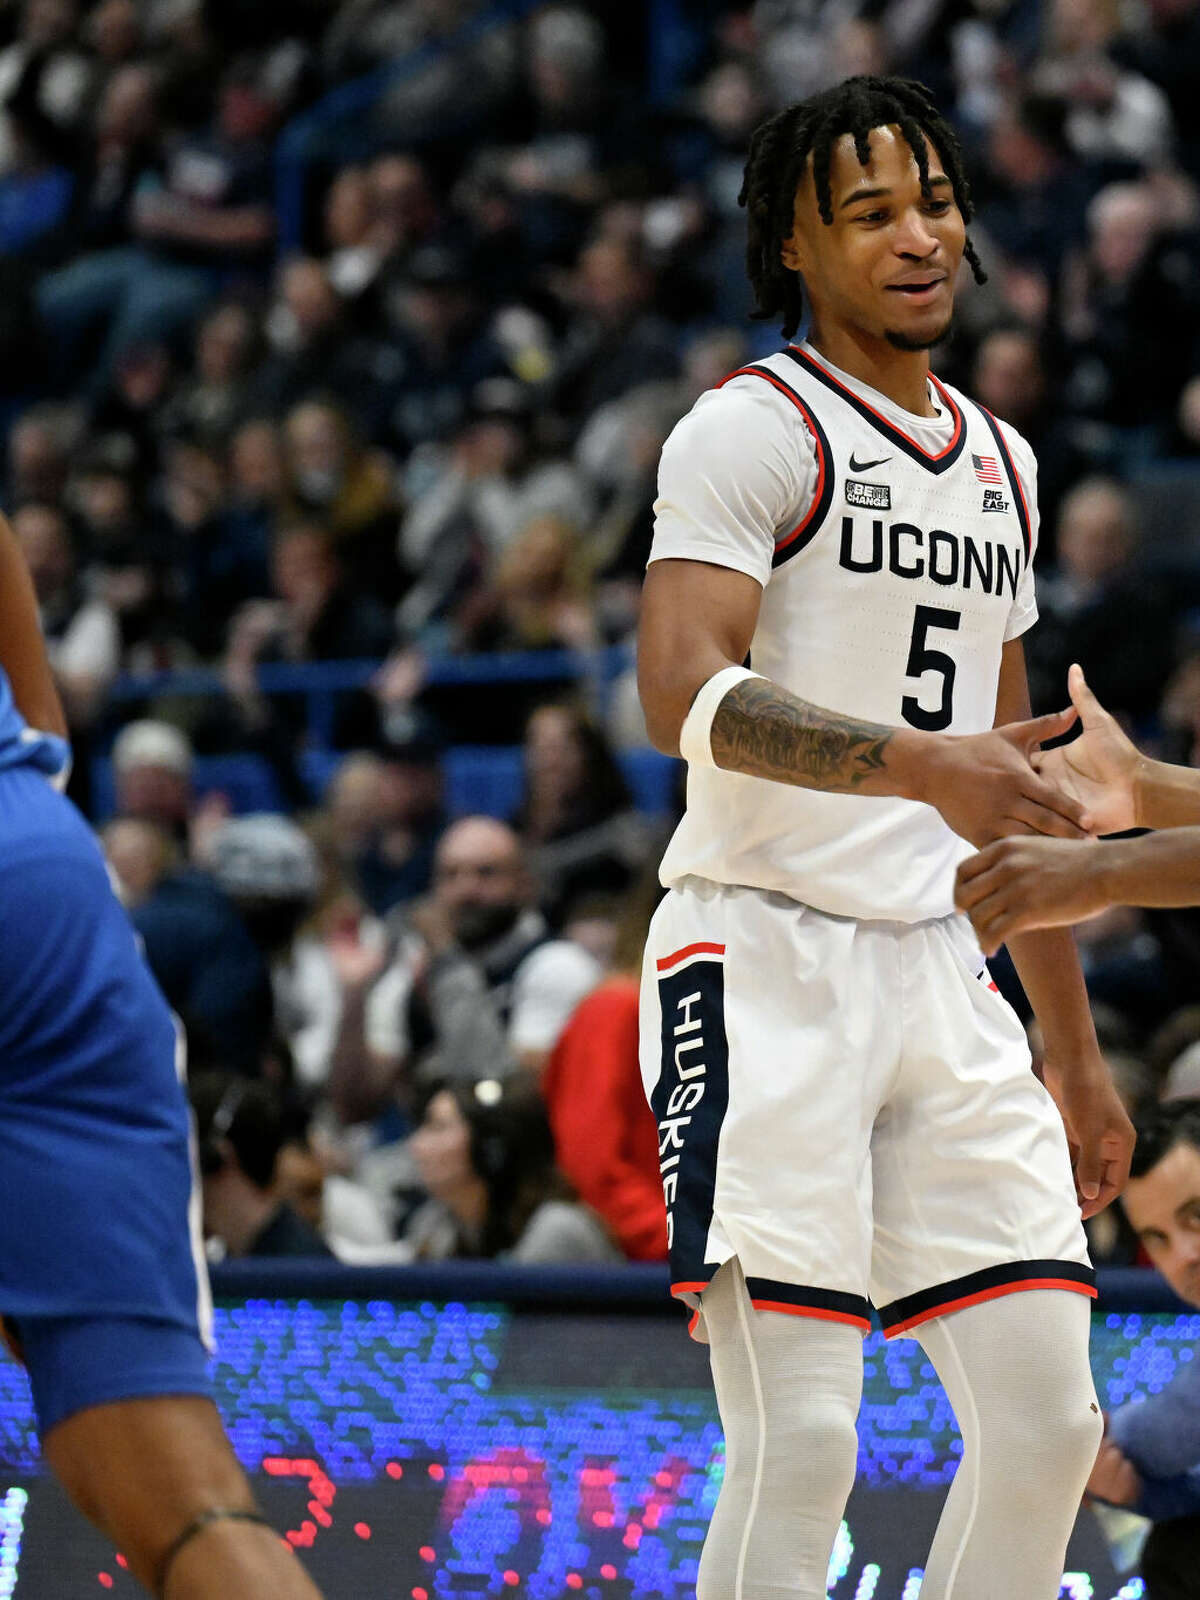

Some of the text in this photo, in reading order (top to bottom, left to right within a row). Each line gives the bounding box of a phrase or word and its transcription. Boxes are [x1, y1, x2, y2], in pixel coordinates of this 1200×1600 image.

[853, 483, 873, 497] BE
[983, 489, 1003, 501] BIG
[846, 493, 889, 507] CHANGE
[982, 499, 1010, 511] EAST
[839, 516, 1021, 601] UCONN
[900, 604, 962, 732] 5
